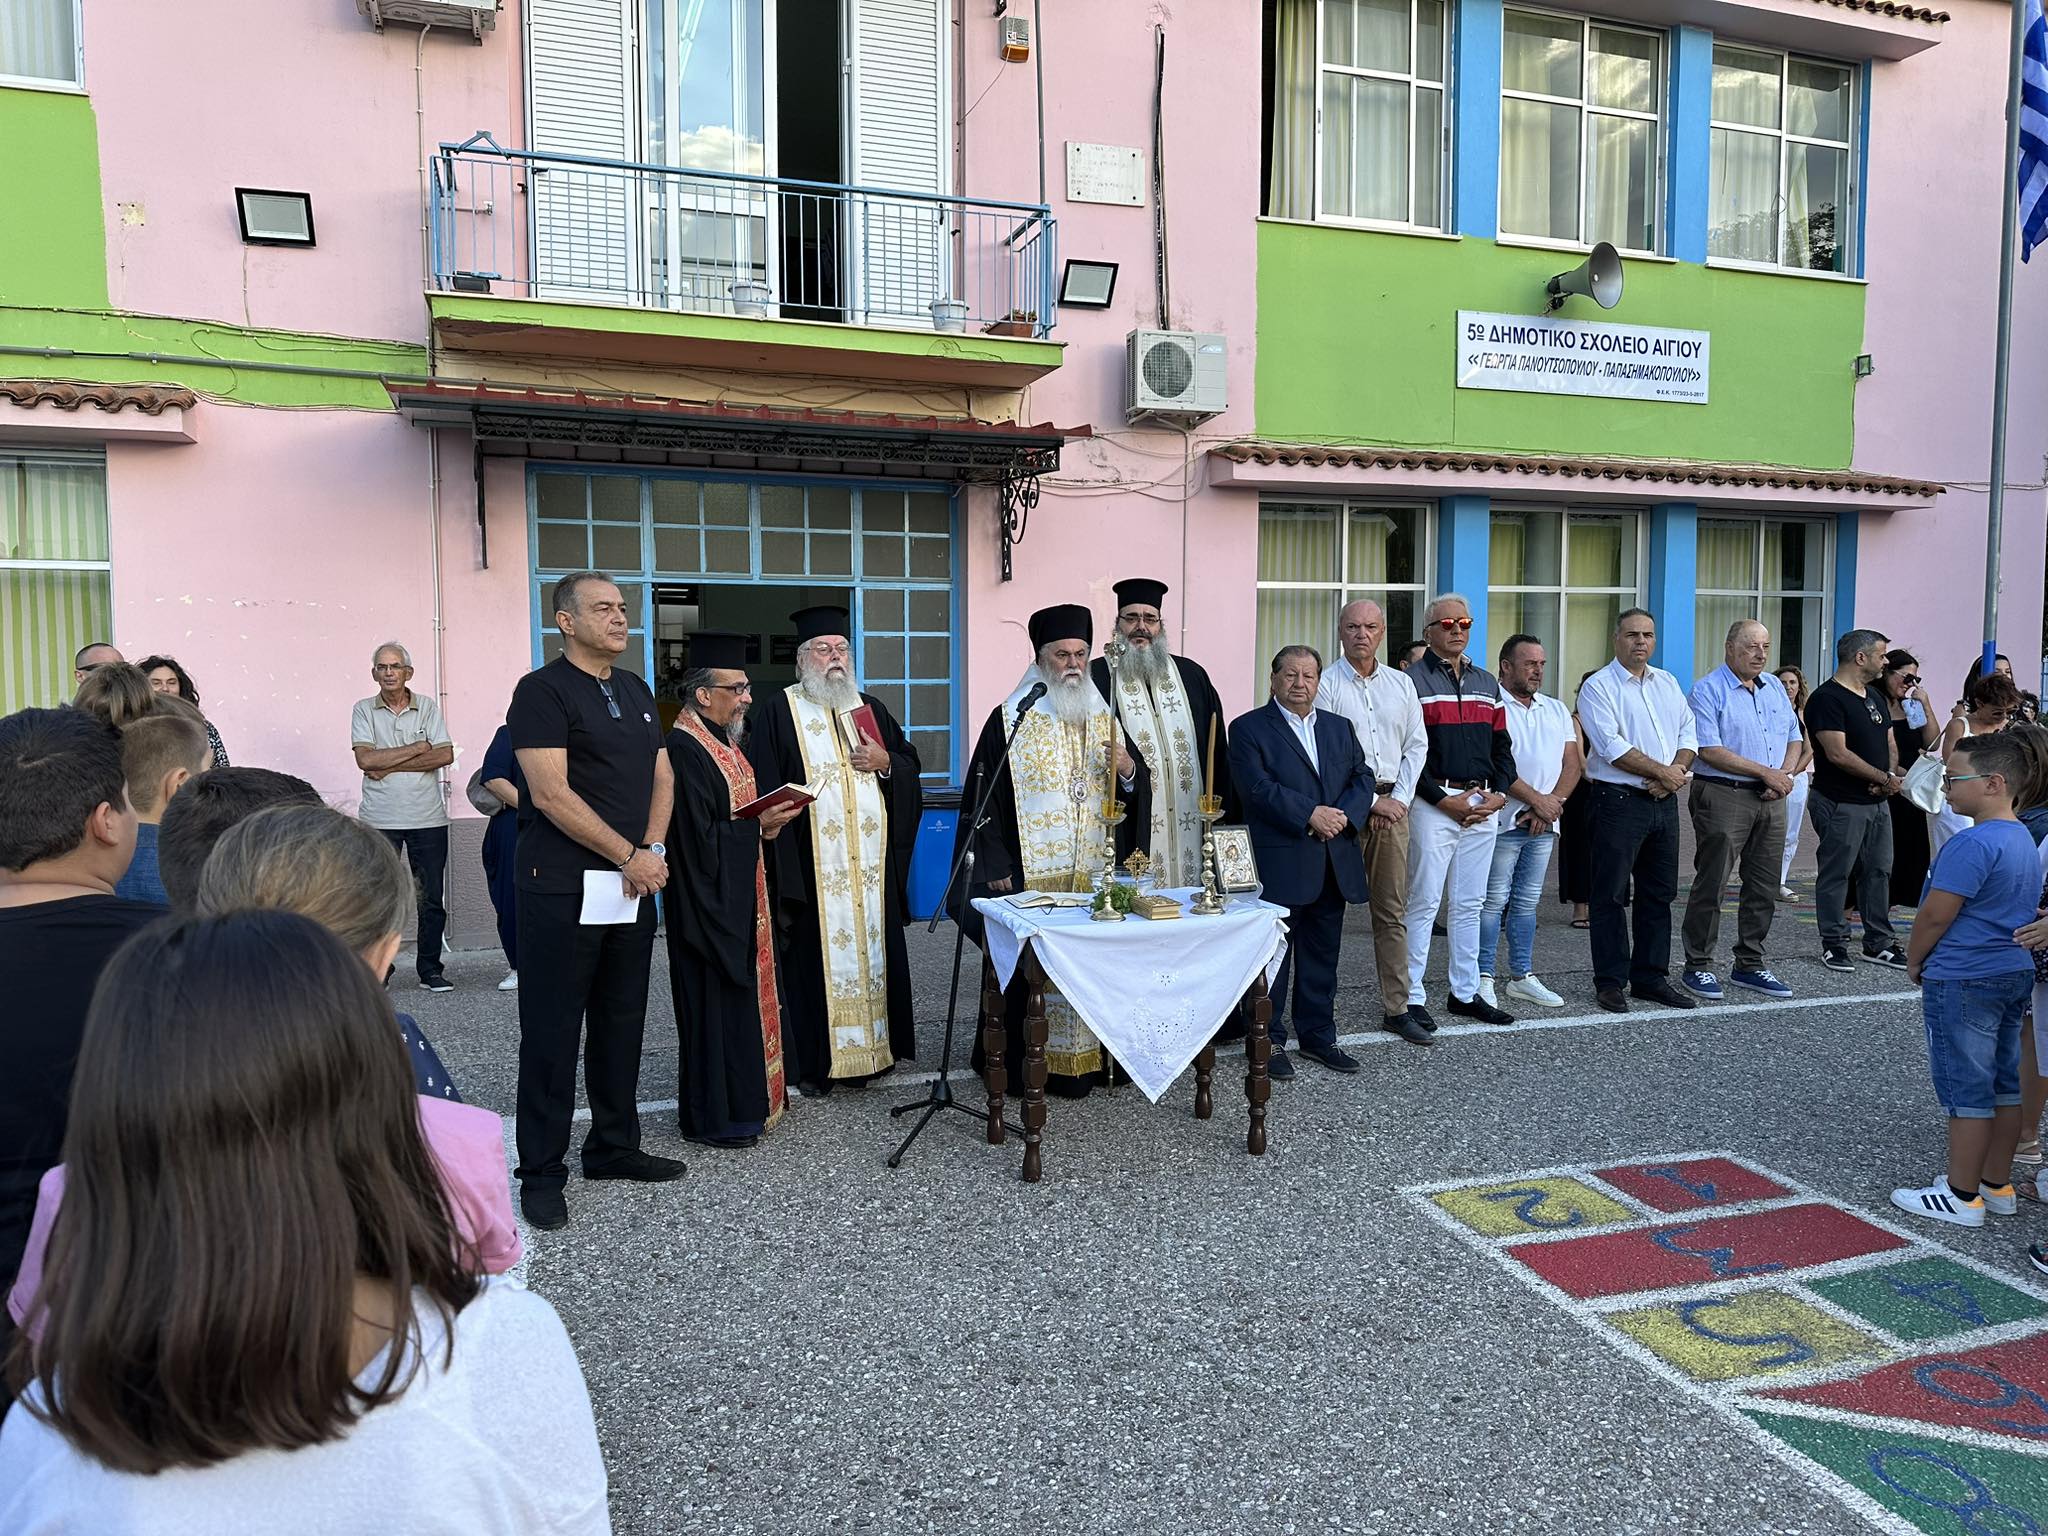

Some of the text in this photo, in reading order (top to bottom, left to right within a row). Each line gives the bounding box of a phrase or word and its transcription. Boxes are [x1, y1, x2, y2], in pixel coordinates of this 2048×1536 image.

[1488, 324, 1576, 349] ΔΗΜΟΤΙΚΟ
[1580, 332, 1649, 355] ΣΧΟΛΕΙΟ
[1652, 338, 1702, 359] ΑΙΓΙΟΥ
[1517, 355, 1599, 377] ΠΑΝΟΥΤΣΟΠΟΥΛΟΥ
